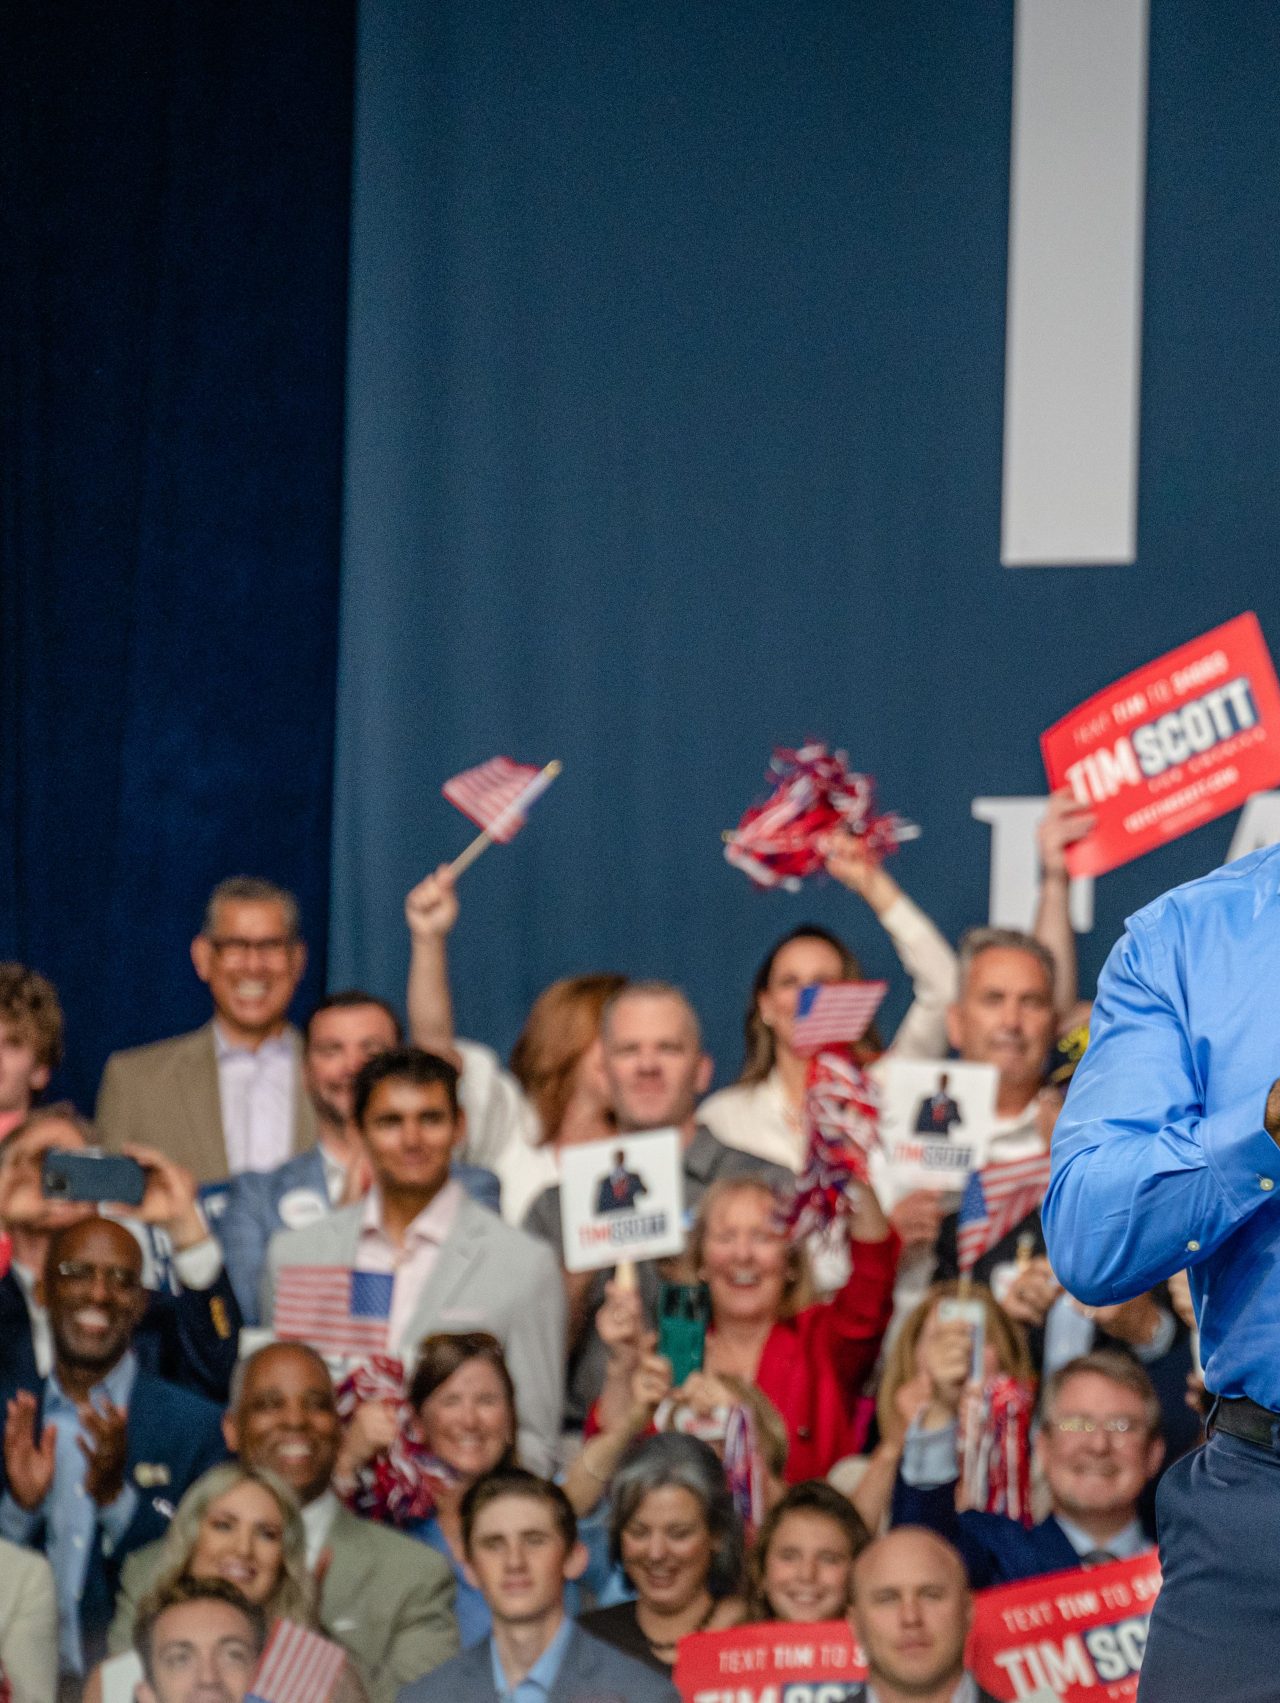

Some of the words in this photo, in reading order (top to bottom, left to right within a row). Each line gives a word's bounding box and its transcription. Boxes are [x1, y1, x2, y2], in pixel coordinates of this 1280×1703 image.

[1065, 736, 1142, 804] TIM
[1132, 677, 1258, 776] SCOTT
[1003, 1602, 1053, 1633] TEXT
[1055, 1586, 1100, 1621] TIM
[1101, 1581, 1128, 1609] TO
[773, 1643, 815, 1669] TIM
[994, 1635, 1102, 1700] TIM
